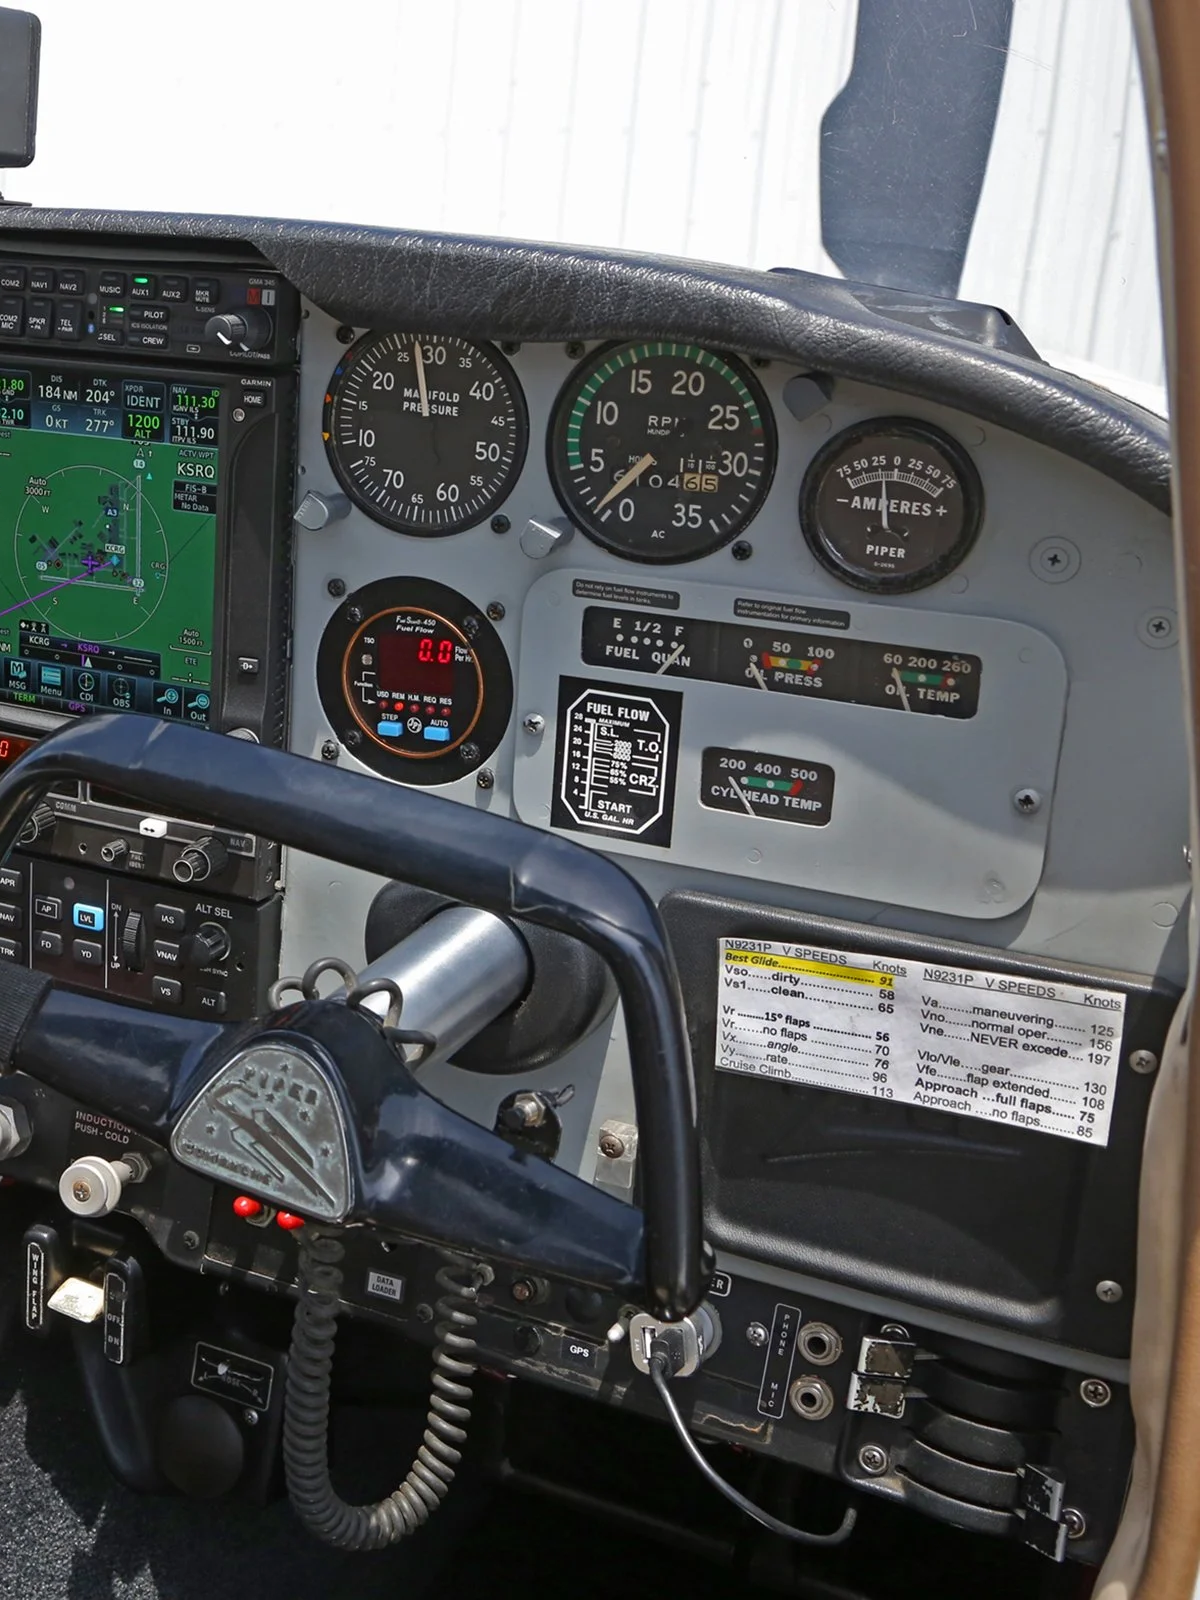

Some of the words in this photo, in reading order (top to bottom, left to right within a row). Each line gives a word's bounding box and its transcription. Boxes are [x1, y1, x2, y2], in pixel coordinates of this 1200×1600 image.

[1, 279, 20, 287] COM2
[31, 281, 48, 289] NAV1
[60, 283, 77, 291] NAV2
[132, 288, 149, 296] AUX1
[144, 311, 164, 319] PILOT
[142, 336, 164, 345] CREW
[397, 352, 410, 363] 25
[423, 345, 447, 365] 30
[459, 358, 472, 369] 35
[241, 378, 271, 387] GARMIN
[372, 372, 395, 391] 20
[631, 369, 652, 394] 15
[671, 370, 705, 396] 20
[38, 385, 61, 399] 184
[63, 390, 78, 400] NM
[403, 388, 460, 403] MAIFOLD
[469, 381, 495, 401] 40
[127, 396, 161, 408] IDENT
[177, 395, 216, 409] 111.30
[244, 395, 263, 404] HOME
[402, 402, 459, 417] PRESURE
[596, 401, 619, 425] 10
[128, 414, 160, 429] 1200
[491, 416, 505, 427] 45
[708, 405, 740, 431] 25
[358, 429, 375, 448] 10
[475, 441, 500, 462] 50
[590, 448, 605, 472] 5
[717, 451, 748, 477] 30
[837, 466, 851, 478] 75
[853, 459, 868, 470] 50
[872, 456, 886, 466] 25
[894, 456, 901, 465] 0
[177, 462, 215, 478] KSRQ
[383, 469, 405, 489] 70
[436, 483, 459, 502] 60
[619, 499, 635, 522] 0
[851, 496, 931, 516] AMPERES
[671, 503, 702, 528] 35
[651, 530, 665, 539] AC
[866, 545, 905, 558] PIPER
[415, 626, 434, 634] Flow
[613, 618, 622, 628] E
[634, 621, 661, 634] 1/2
[675, 626, 684, 636] F
[419, 639, 452, 663] 0.0
[605, 645, 639, 660] FUEL
[772, 641, 791, 653] 50
[807, 646, 834, 659] 100
[884, 653, 902, 665] 60
[908, 656, 937, 669] 200
[942, 660, 971, 673] 260
[774, 671, 823, 688] PRESS
[40, 685, 62, 697] Menu
[917, 688, 960, 703] TEMP
[190, 711, 207, 722] Out
[381, 713, 398, 721] STEP
[587, 702, 613, 716] FUEL
[618, 707, 650, 721] FLOW
[430, 719, 448, 727] AUTO
[599, 718, 630, 727] MAXIMUM
[637, 739, 662, 754] T.O.
[610, 761, 628, 769] 75%
[720, 758, 746, 770] 200
[754, 763, 781, 775] 400
[791, 768, 818, 781] 500
[629, 774, 659, 788] CRZ.
[711, 785, 738, 798] CYL
[743, 790, 779, 805] HEAD
[783, 795, 822, 811] TEMP
[597, 800, 632, 813] START
[230, 838, 246, 848] NAV
[0, 878, 16, 888] APR
[0, 913, 15, 923] NAV
[195, 903, 214, 916] ALT
[215, 906, 233, 919] SEL
[80, 914, 94, 924] LVL
[161, 914, 175, 925] IAS
[0, 947, 16, 958] TRK
[156, 950, 178, 963] VNAV
[725, 939, 772, 952] N9231P
[782, 945, 792, 956] V
[794, 948, 848, 965] SPEEDS
[872, 960, 907, 975] Knots
[725, 952, 749, 964] Best
[879, 976, 894, 987] 91
[879, 989, 895, 1001] 58
[923, 968, 974, 985] N9231P
[998, 979, 1056, 998] SPEEDS
[1083, 993, 1121, 1010] Knots
[877, 1002, 894, 1014] 65
[785, 1015, 811, 1029] flaps
[875, 1031, 890, 1042] 56
[1090, 1024, 1115, 1037] 125
[780, 1028, 808, 1042] flaps
[874, 1045, 890, 1056] 70
[874, 1058, 890, 1070] 76
[719, 1056, 756, 1072] Cruise
[872, 1086, 894, 1099] 113
[872, 1071, 888, 1083] 96
[914, 1077, 978, 1099] Approach
[1079, 1110, 1095, 1124] 75
[74, 1122, 98, 1136] PUSH
[104, 1131, 130, 1144] COLD
[31, 1252, 39, 1285] WING
[376, 1274, 395, 1287] DATA
[371, 1282, 398, 1299] LOADER
[778, 1313, 791, 1357] PHONE
[569, 1343, 590, 1358] GPS
